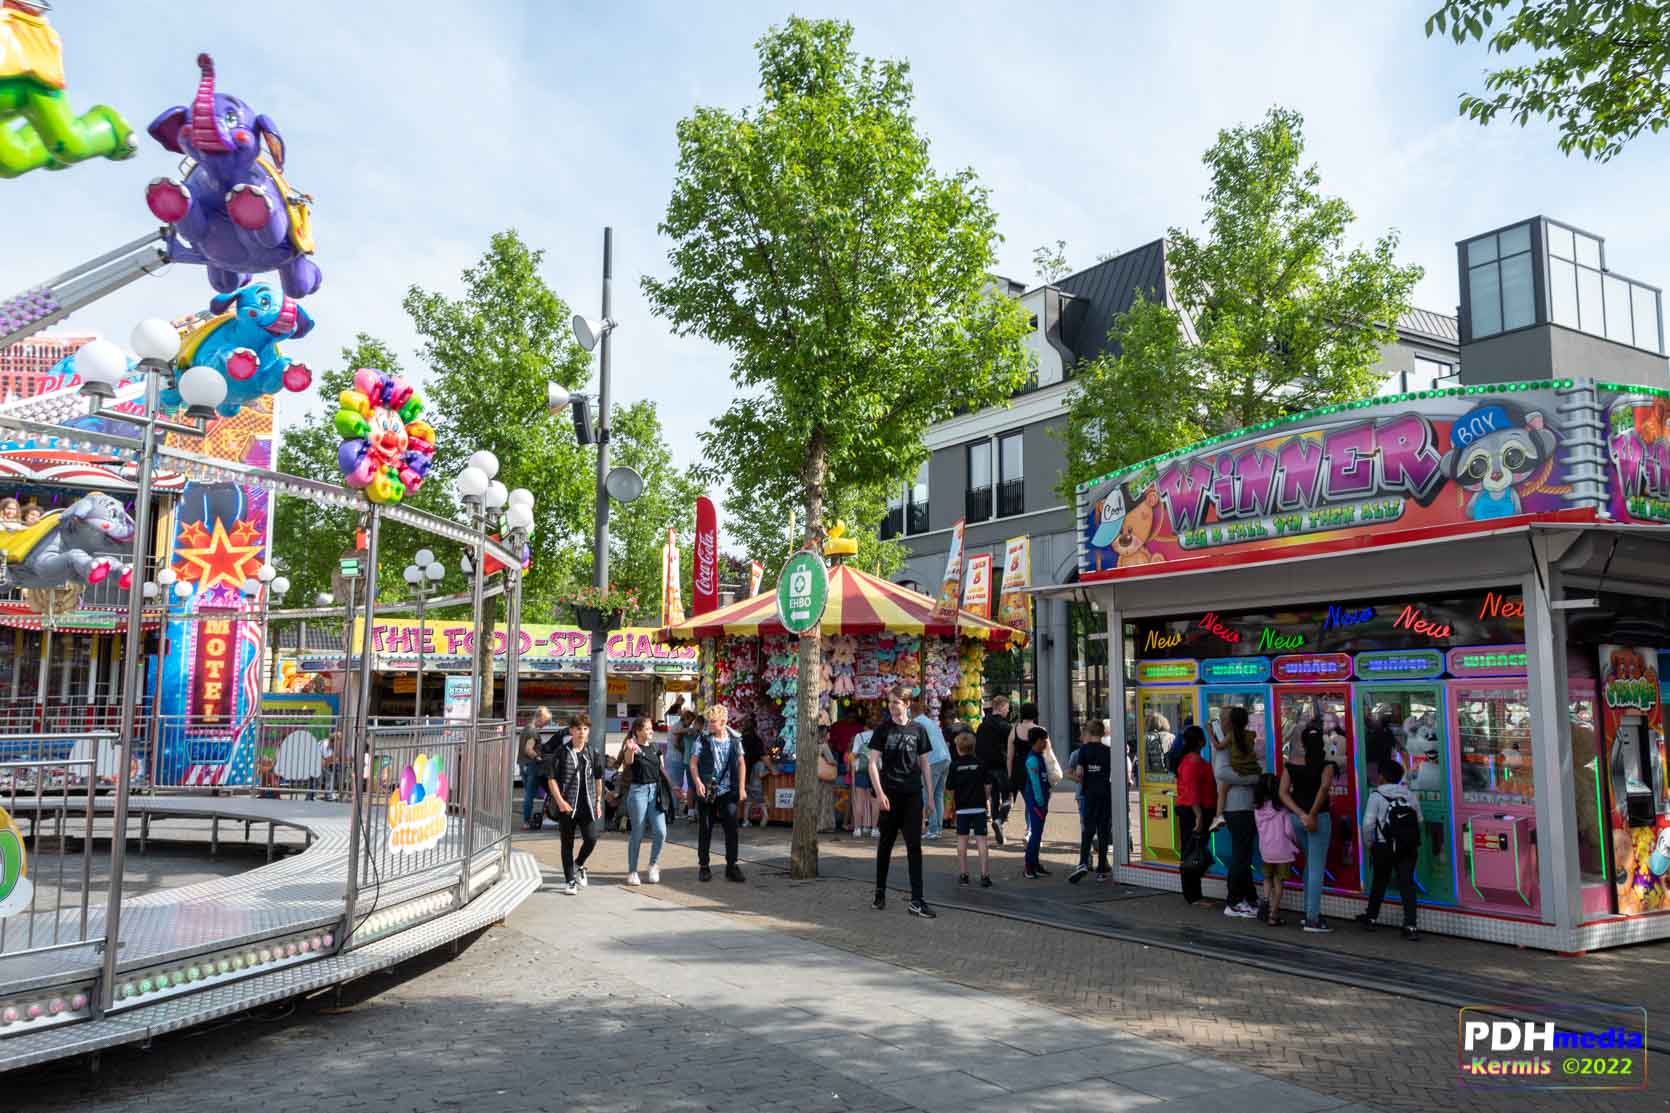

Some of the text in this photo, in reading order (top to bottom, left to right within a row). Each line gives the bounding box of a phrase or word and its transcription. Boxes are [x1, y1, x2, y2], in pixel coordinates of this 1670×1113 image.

[1457, 412, 1495, 445] BOY
[1103, 494, 1122, 521] Cool
[695, 530, 715, 596] Coca-Cola
[789, 597, 812, 609] EHBO
[1199, 611, 1240, 643] New
[1323, 605, 1374, 631] New
[1393, 604, 1450, 638] New
[371, 625, 435, 653] THE
[1145, 630, 1182, 652] New
[1258, 626, 1304, 650] New
[203, 618, 231, 722] MOTEL
